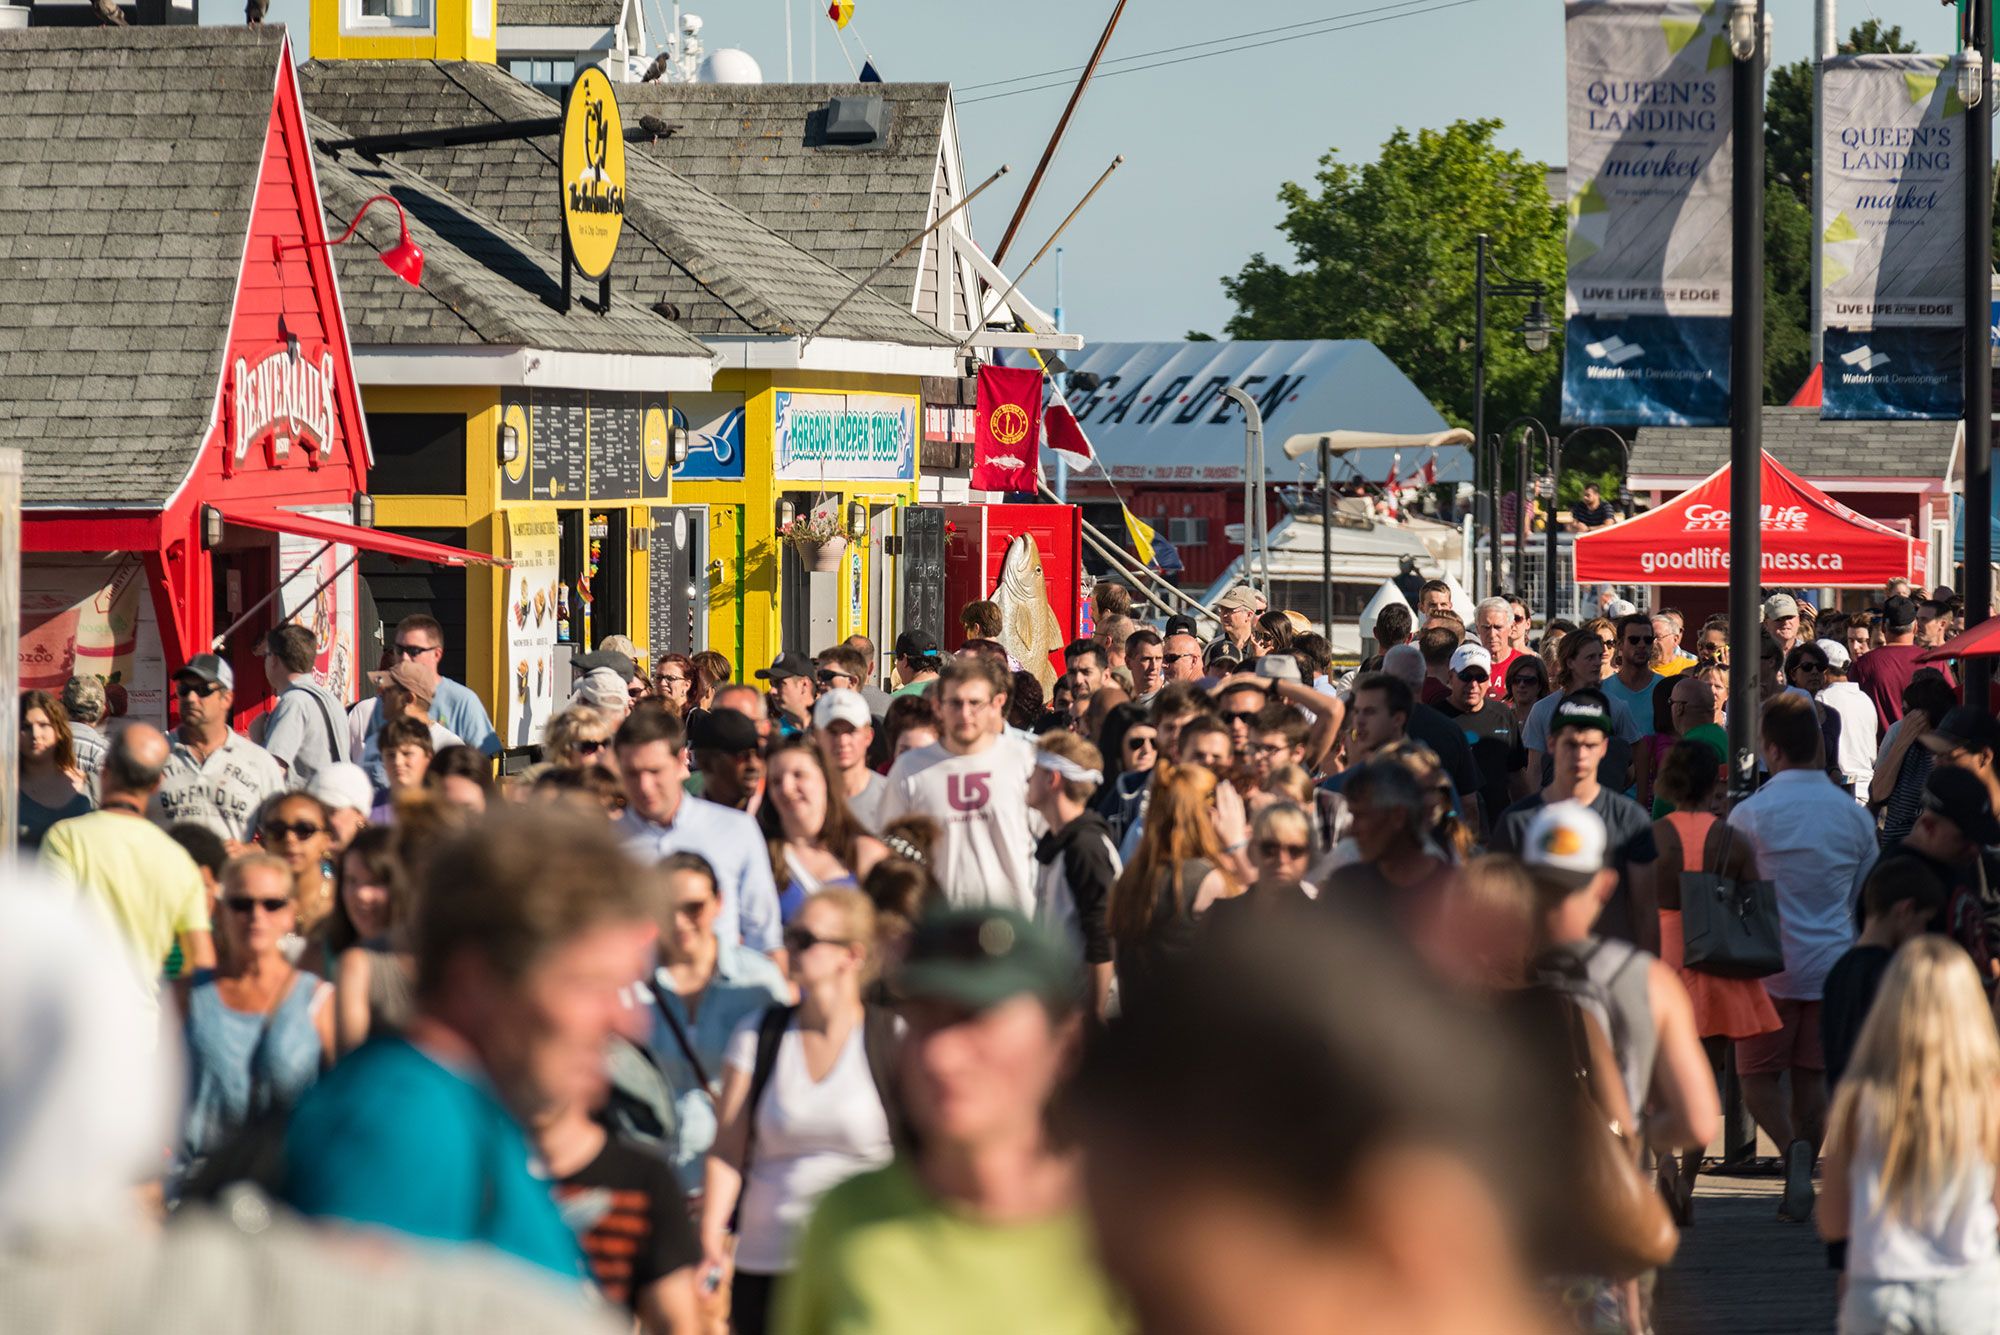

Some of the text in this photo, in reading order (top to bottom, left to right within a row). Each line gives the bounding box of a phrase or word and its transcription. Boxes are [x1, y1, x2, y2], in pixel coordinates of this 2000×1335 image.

[1587, 80, 1717, 107] QUEEN'S
[1588, 109, 1716, 131] LANDING
[1841, 126, 1951, 150] QUEEN'S
[1605, 149, 1702, 179] market
[1842, 151, 1950, 170] LANDING
[1856, 184, 1937, 209] market
[1583, 287, 1614, 300] LIVE
[1618, 288, 1648, 301] LIFE
[1679, 288, 1720, 301] EDGE
[1836, 303, 1863, 314] LIVE
[1866, 304, 1892, 315] LIFE
[1919, 304, 1953, 315] EDGE
[1587, 365, 1712, 381] Waterfront Development
[1842, 373, 1948, 385] Waterfront Development
[871, 411, 898, 461] TOURS
[1684, 503, 1809, 522] GoLife
[1684, 521, 1806, 530] FITESS
[1641, 547, 1843, 573] goodlifeness.ca
